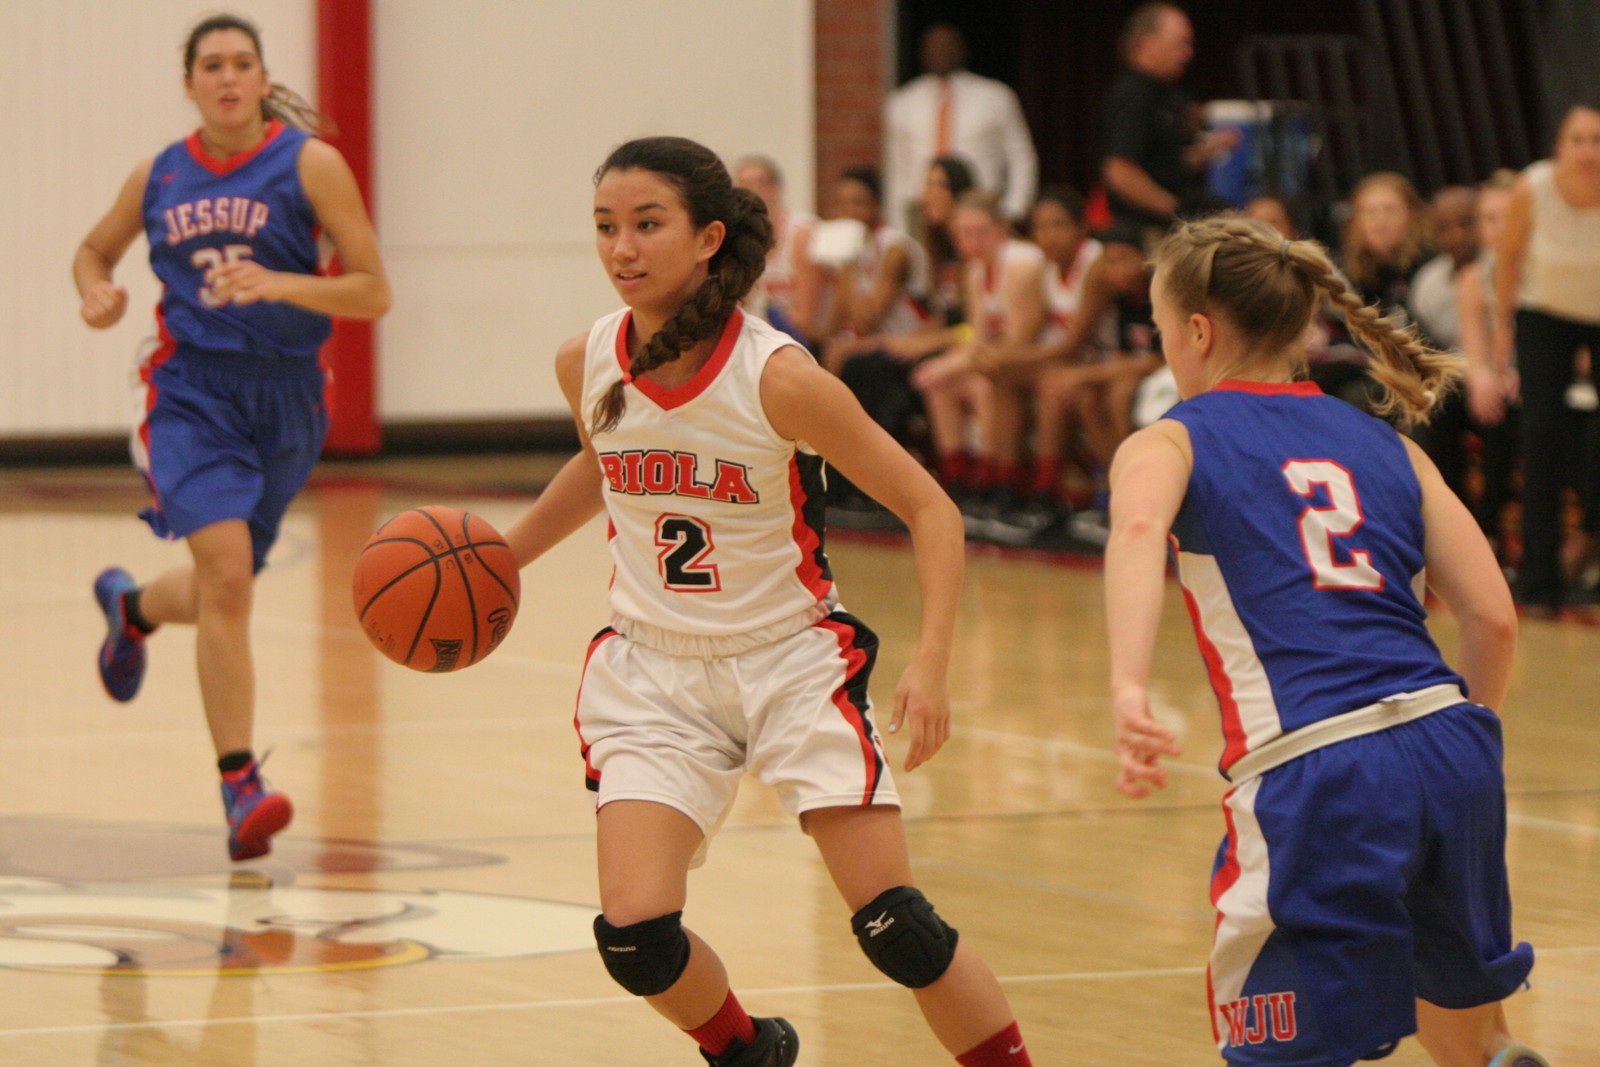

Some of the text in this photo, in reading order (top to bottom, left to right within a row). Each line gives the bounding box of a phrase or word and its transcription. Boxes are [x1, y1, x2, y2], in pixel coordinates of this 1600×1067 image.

[164, 196, 270, 247] JESSUP
[599, 449, 760, 504] BIOLA
[654, 512, 722, 593] 2
[1281, 457, 1386, 592] 2
[1218, 990, 1298, 1048] WJU
